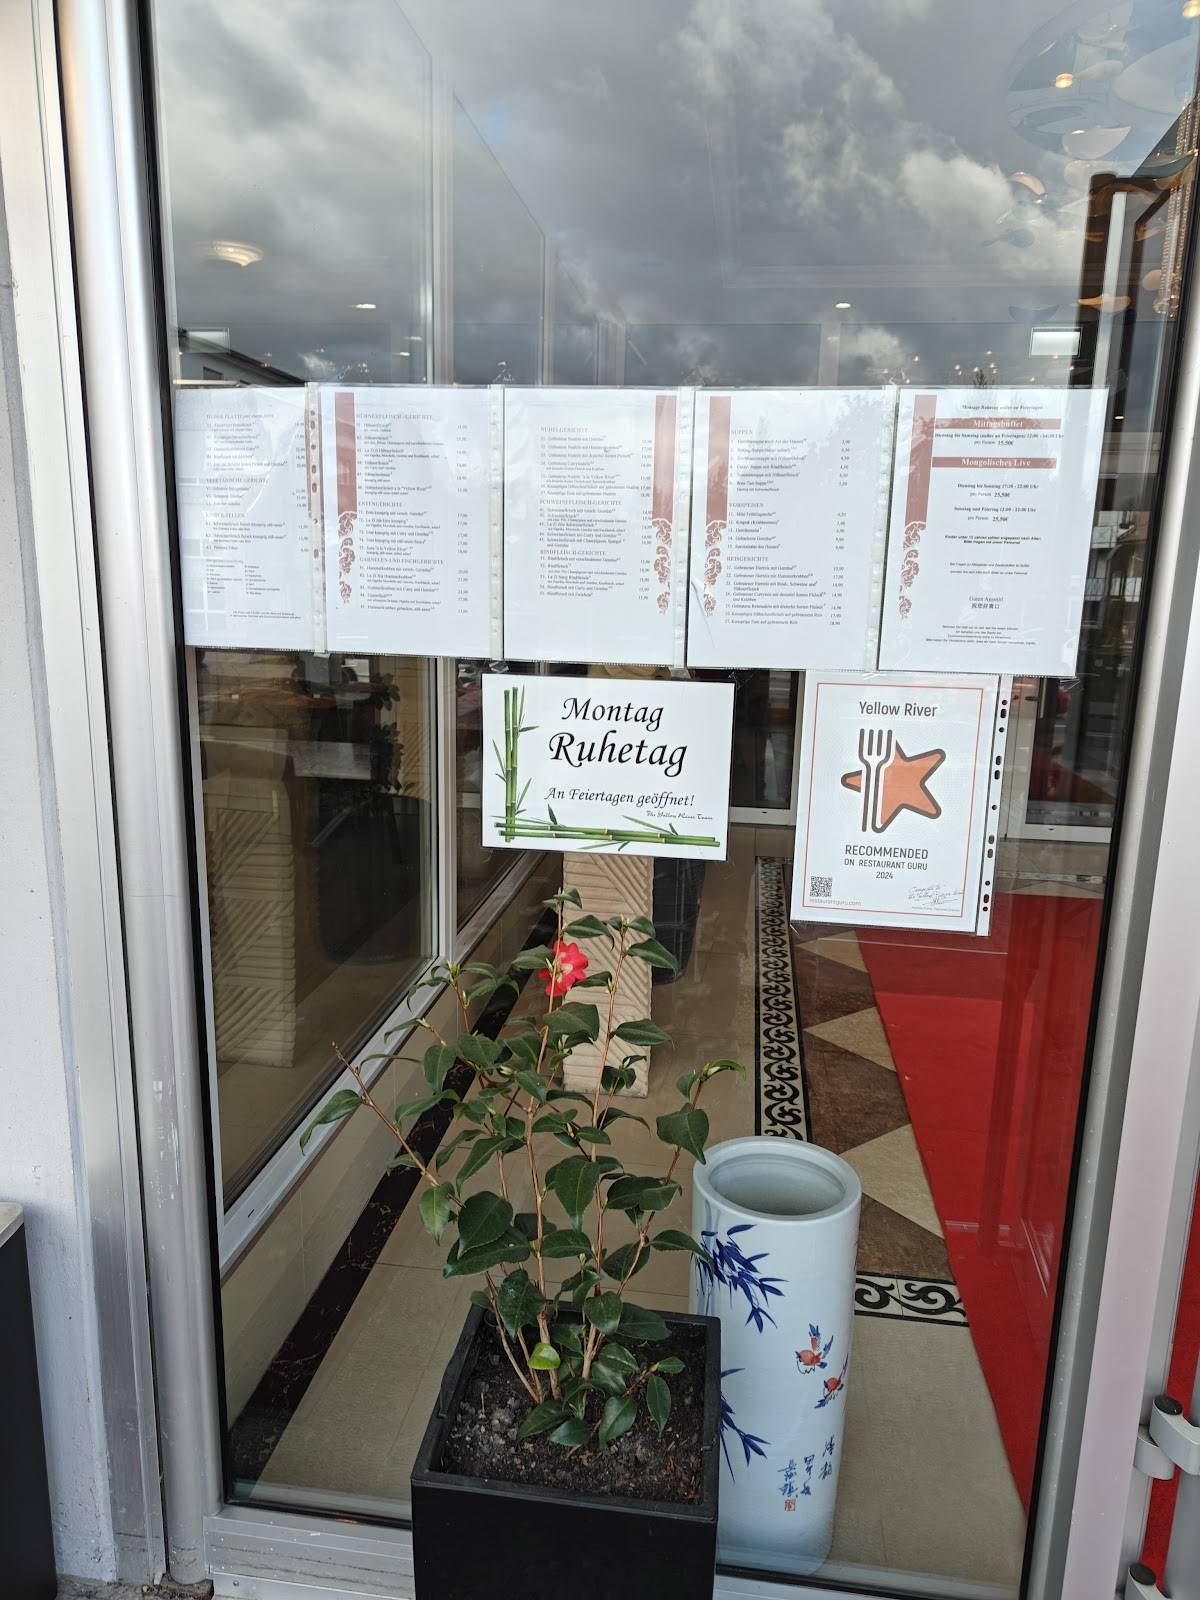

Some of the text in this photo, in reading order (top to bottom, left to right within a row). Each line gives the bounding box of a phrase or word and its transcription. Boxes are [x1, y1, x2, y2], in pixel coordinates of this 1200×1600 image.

[962, 458, 1031, 467] Mongolisches Live
[562, 697, 664, 732] Montag
[859, 701, 938, 717] Yellow River
[548, 730, 688, 777] Ruhetag
[544, 787, 696, 808] An Feiertagen geöffnet!
[845, 844, 929, 860] RECOMMENDED
[844, 858, 928, 870] ON RESTAURANT GURU
[876, 871, 894, 880] 2024
